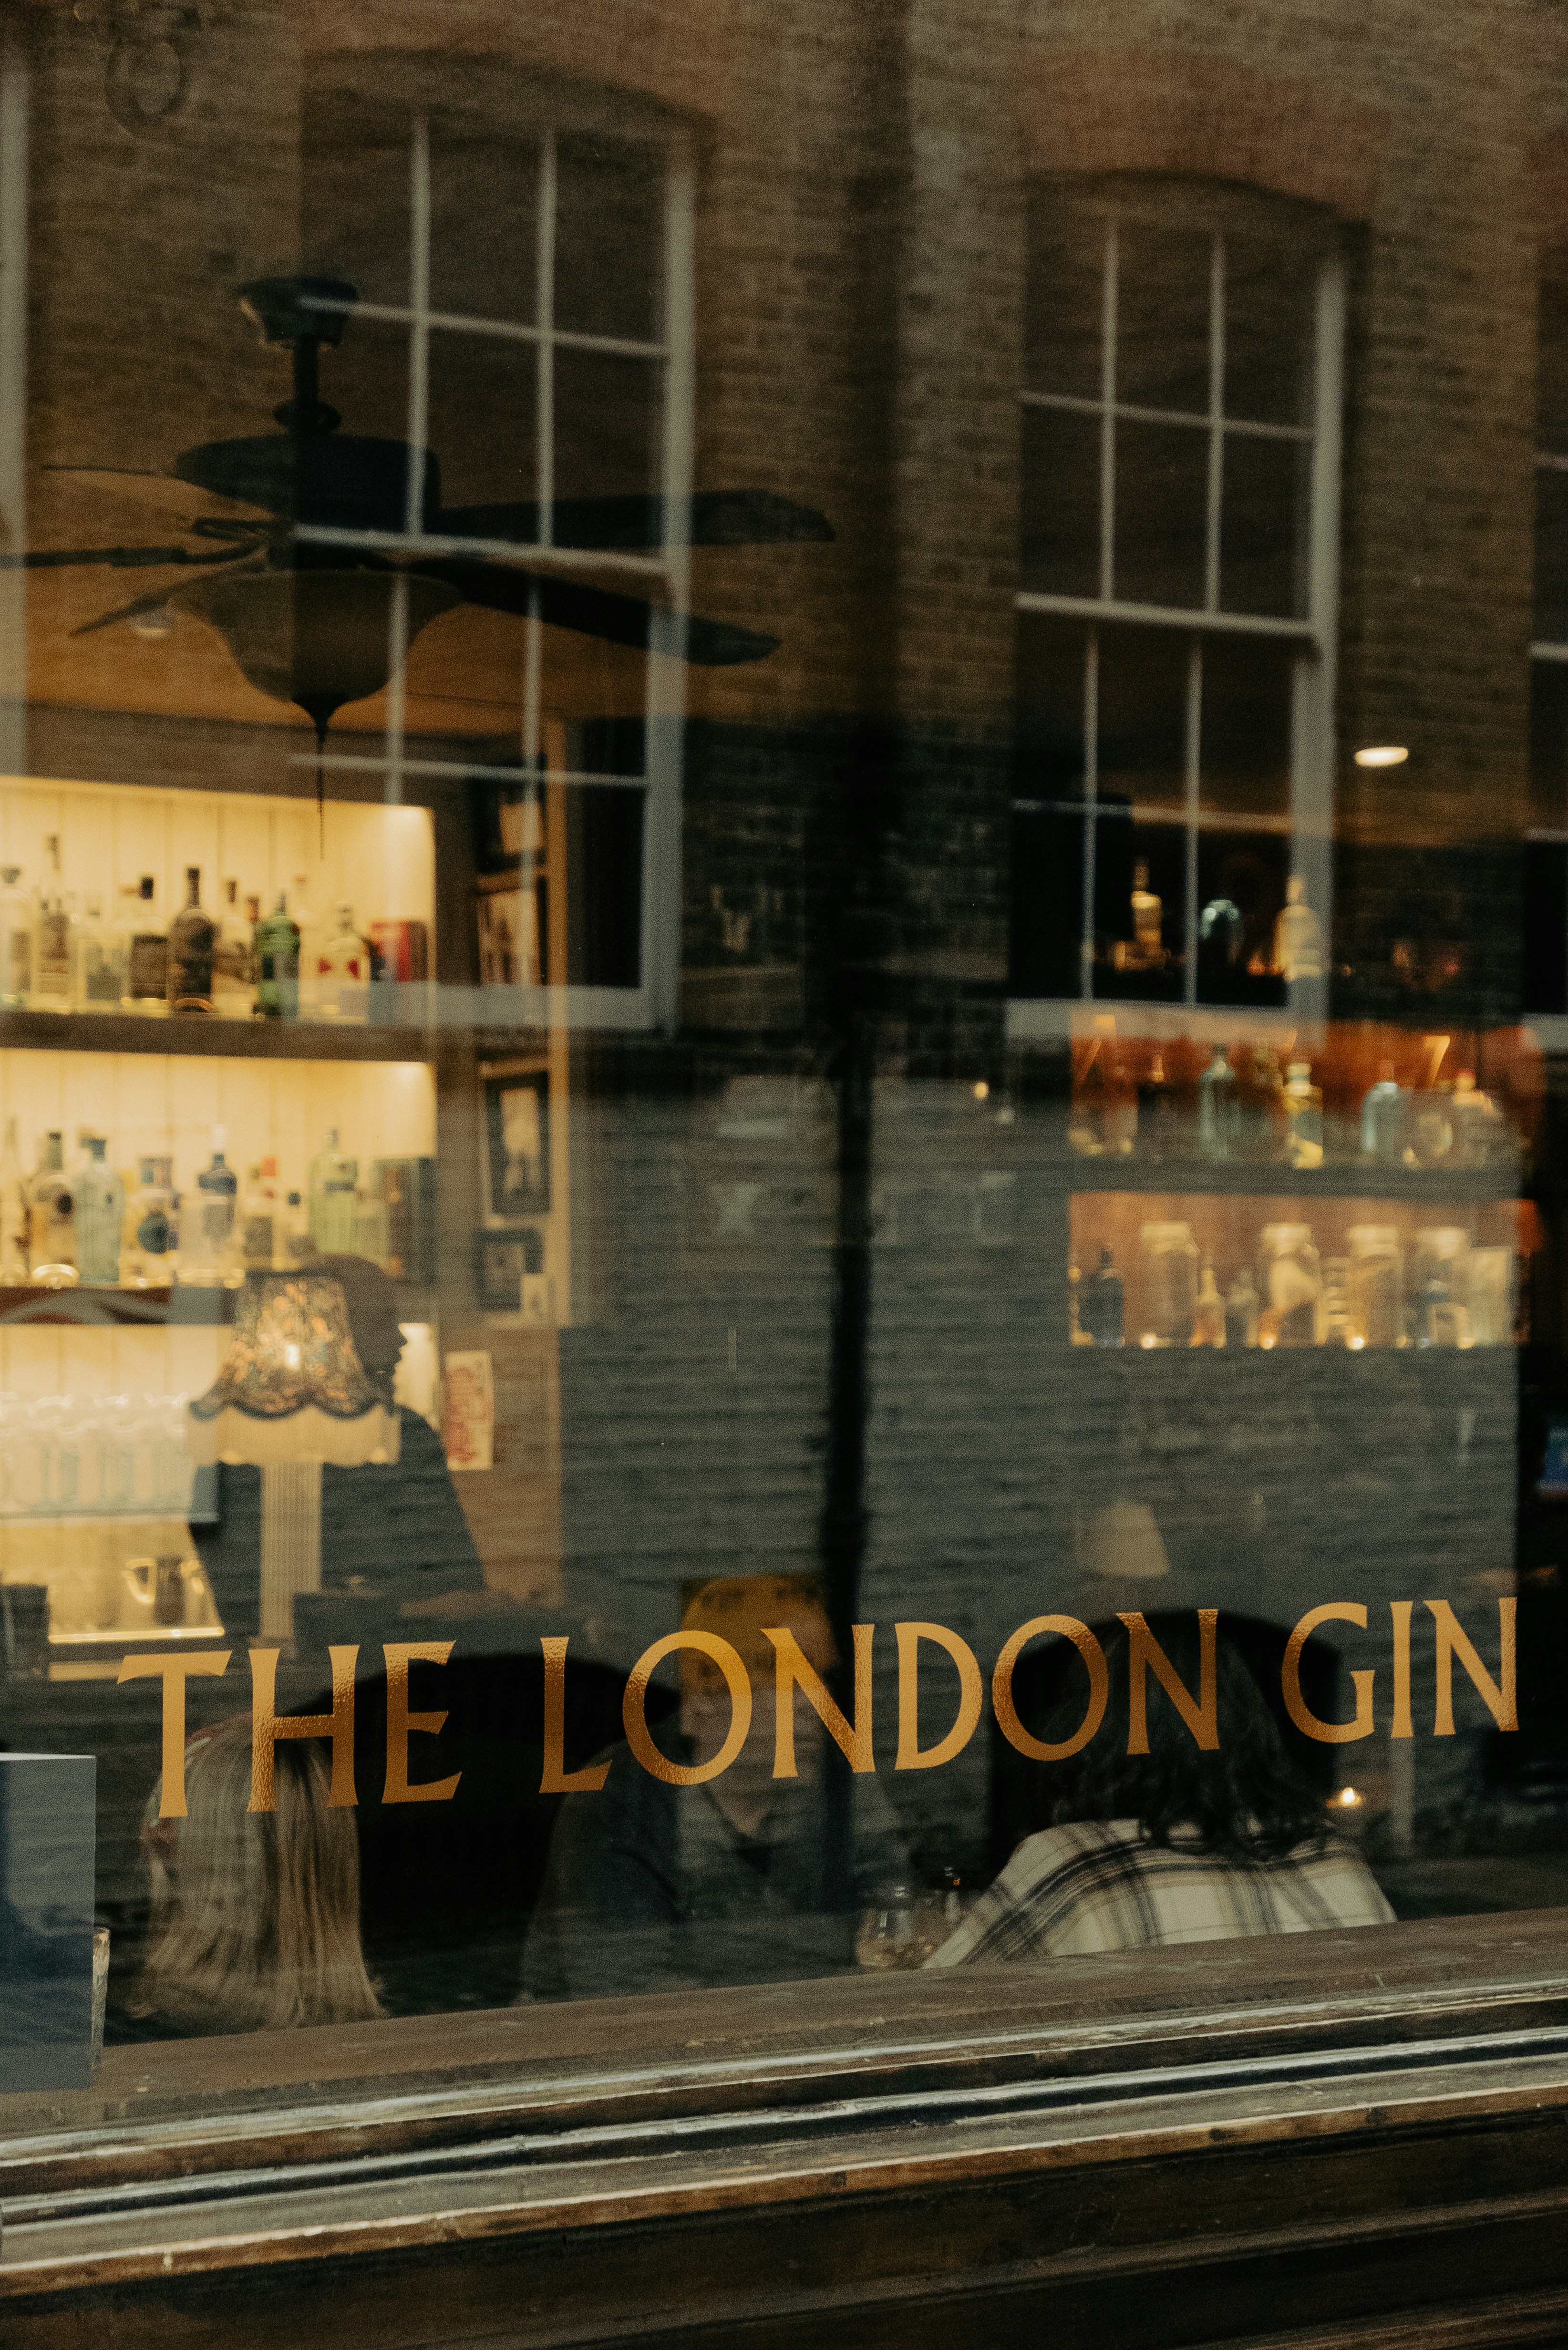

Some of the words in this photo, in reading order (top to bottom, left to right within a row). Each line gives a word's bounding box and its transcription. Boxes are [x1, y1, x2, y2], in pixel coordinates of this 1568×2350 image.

[116, 1639, 463, 1819] THE
[538, 1608, 1220, 1793] LONDON
[1281, 1597, 1519, 1743] GIN
